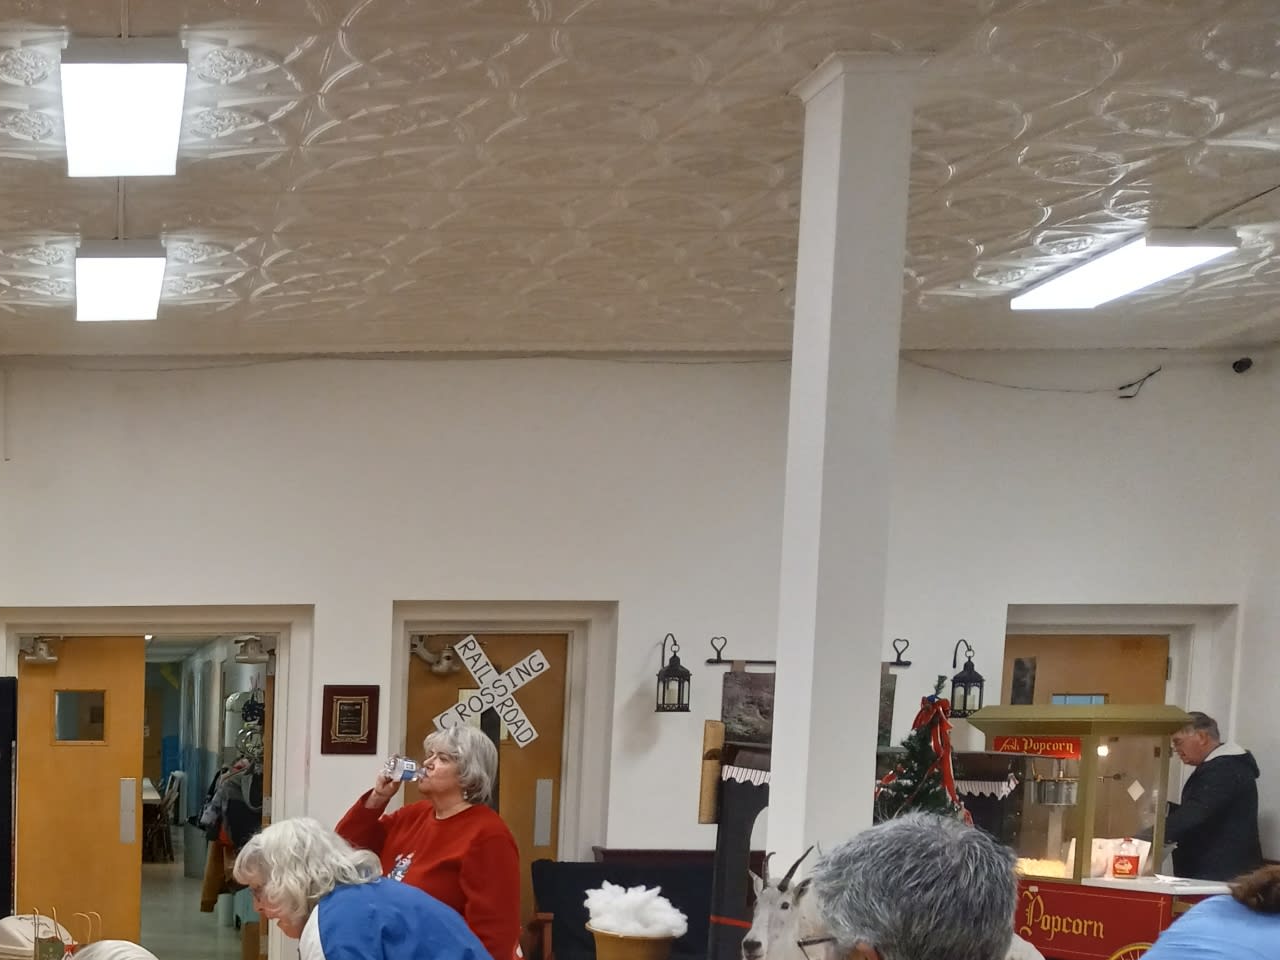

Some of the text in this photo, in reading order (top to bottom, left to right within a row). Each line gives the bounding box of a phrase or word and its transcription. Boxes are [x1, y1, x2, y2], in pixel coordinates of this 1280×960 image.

[439, 654, 545, 730] CROSSING
[1023, 737, 1075, 755] Popcorn
[1020, 890, 1105, 941] Popcorn
